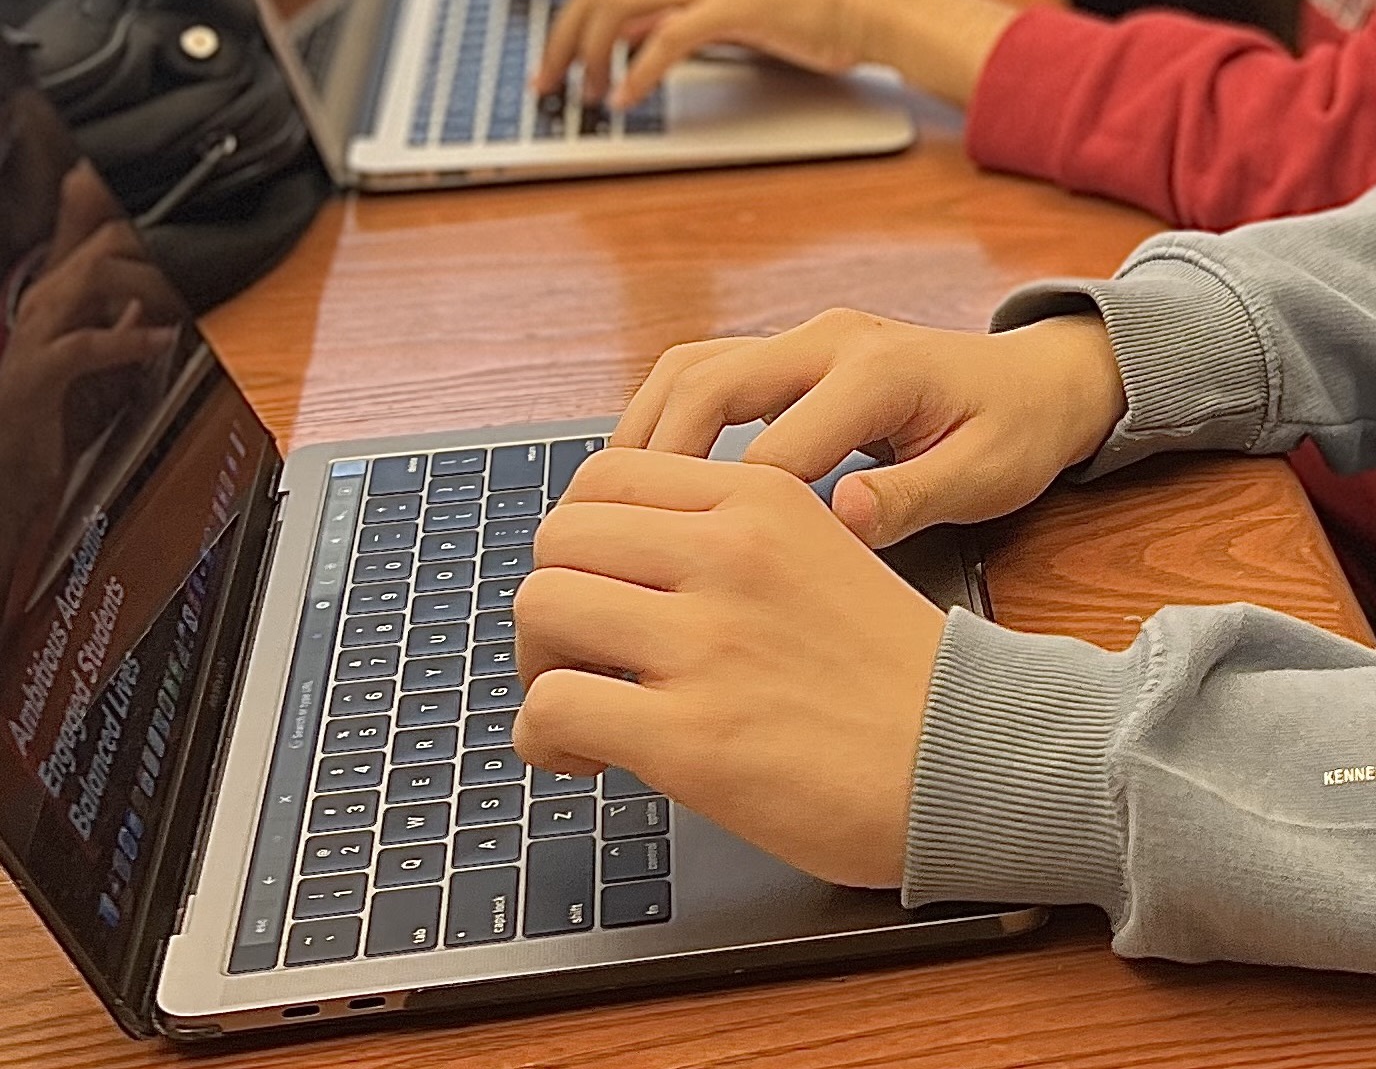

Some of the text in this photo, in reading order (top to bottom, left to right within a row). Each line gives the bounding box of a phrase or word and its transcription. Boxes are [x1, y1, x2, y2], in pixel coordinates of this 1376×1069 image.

[440, 542, 456, 550] P
[380, 592, 398, 601] 9
[499, 588, 515, 597] K
[8, 504, 108, 756] Ambitious Academics
[376, 624, 393, 632] 8
[429, 635, 447, 644] U
[370, 658, 387, 666] 7
[493, 653, 511, 662] H
[425, 668, 442, 678] Y
[38, 576, 124, 797] Engaged Students
[365, 692, 383, 700] 6
[490, 687, 508, 697] G
[420, 704, 438, 713] T
[359, 728, 377, 737] 5
[488, 724, 505, 733] F
[69, 651, 140, 841] Balanced Lives
[415, 739, 434, 749] R
[353, 765, 371, 774] 4
[484, 760, 503, 770] D
[411, 777, 431, 787] E
[346, 804, 366, 814] 3
[481, 799, 500, 809] S
[553, 810, 572, 821] Z
[406, 816, 426, 829] W
[478, 839, 497, 849] A
[340, 845, 360, 855] 2
[400, 859, 422, 870] Q
[492, 895, 507, 933] caps lock
[568, 903, 583, 924] shift
[412, 928, 427, 944] tab
